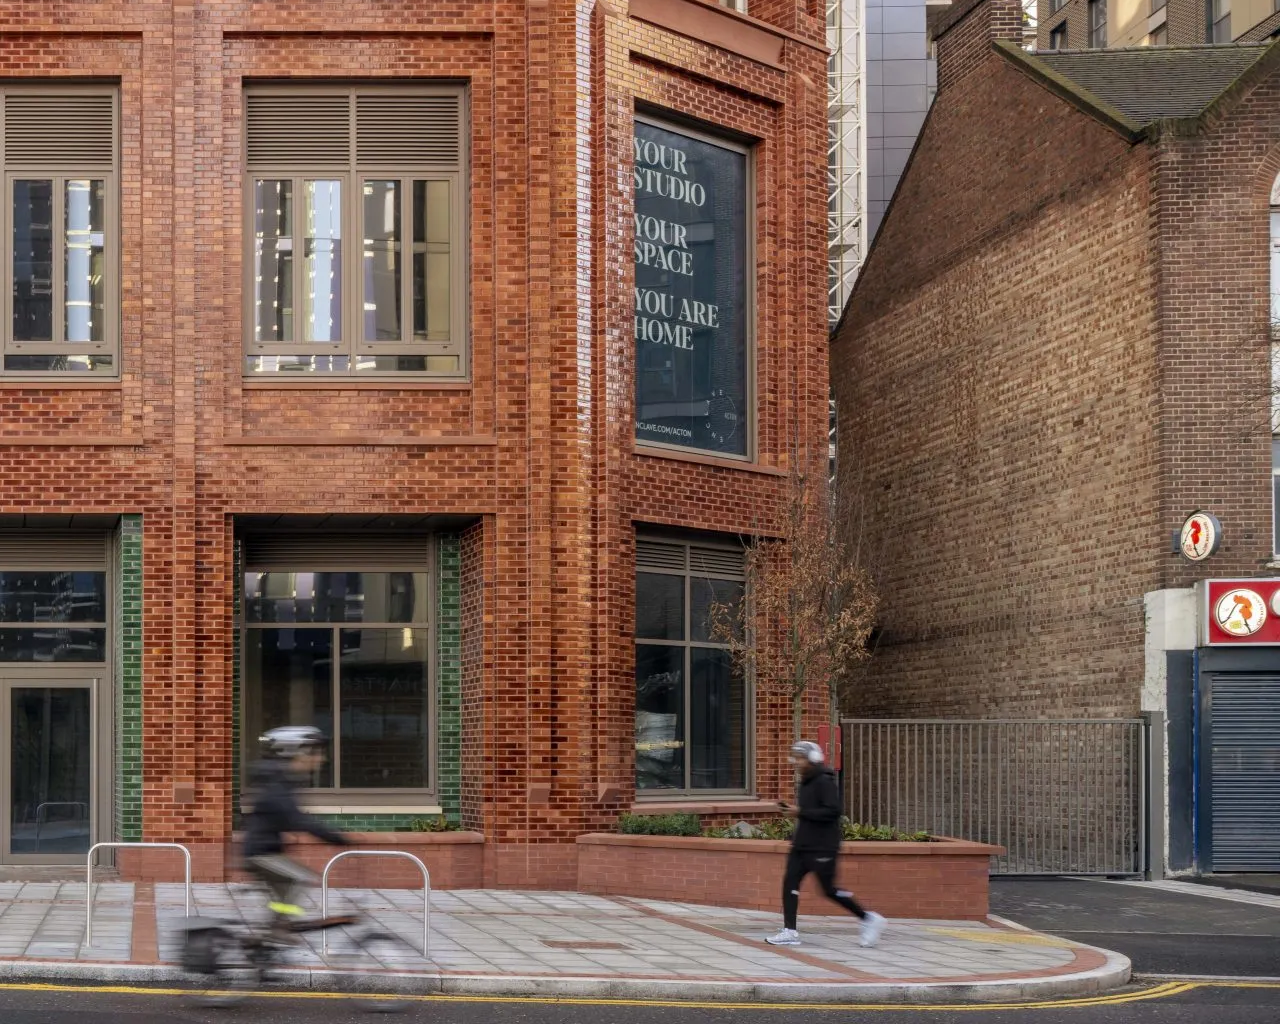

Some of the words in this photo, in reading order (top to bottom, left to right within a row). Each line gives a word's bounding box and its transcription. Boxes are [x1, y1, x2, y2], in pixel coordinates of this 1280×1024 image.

[634, 137, 688, 175] YOUR
[634, 165, 706, 207] STUDIO
[634, 212, 688, 249] YOUR
[634, 239, 694, 276] SPACE
[635, 287, 674, 318] YOU
[678, 298, 719, 328] ARE
[635, 315, 694, 351] HOME
